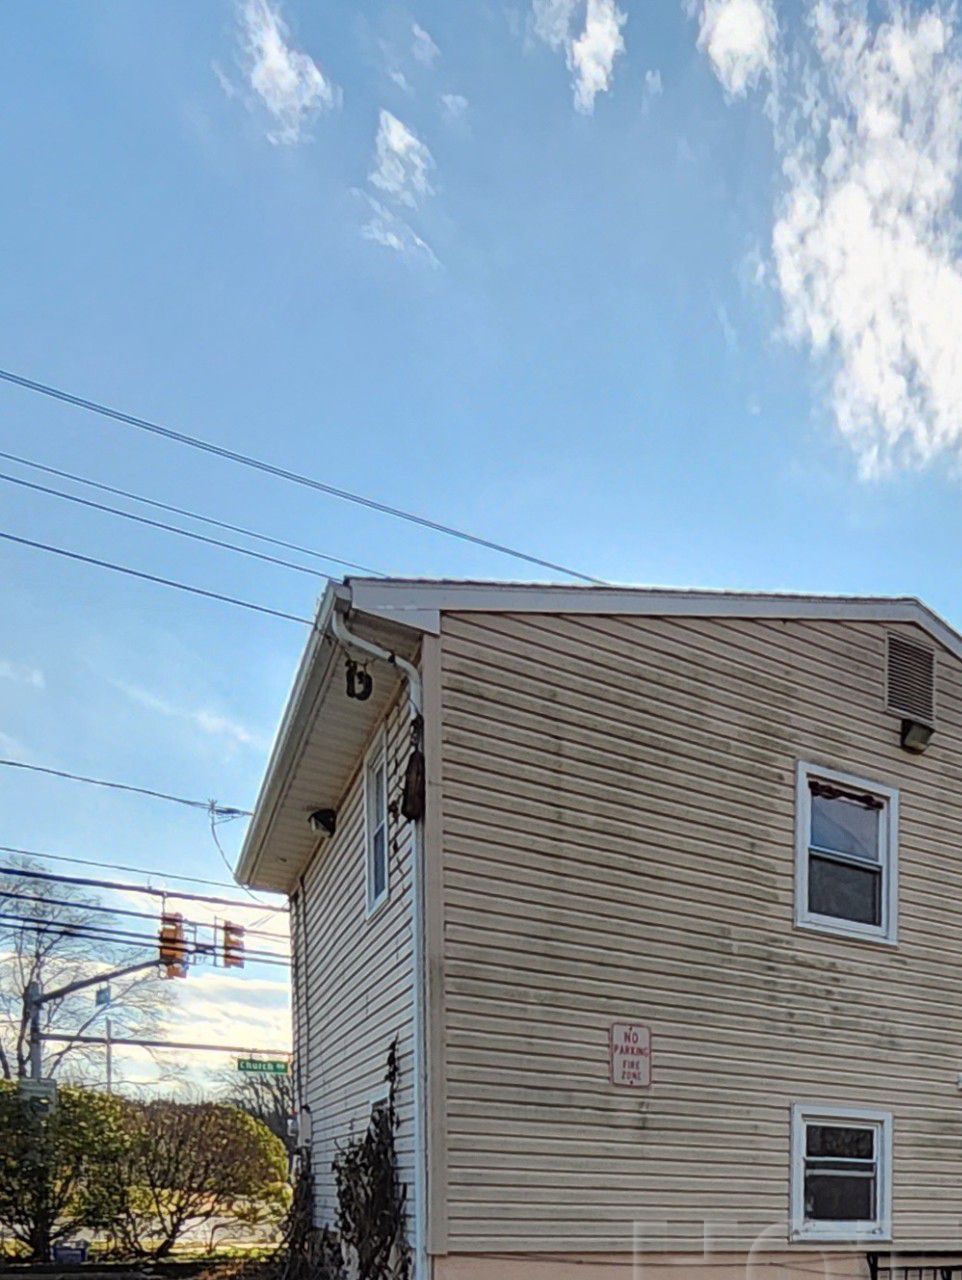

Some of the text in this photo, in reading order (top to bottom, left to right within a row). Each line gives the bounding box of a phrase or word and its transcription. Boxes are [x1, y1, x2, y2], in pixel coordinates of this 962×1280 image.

[624, 1032, 639, 1043] NO
[614, 1044, 649, 1057] PARKING
[240, 1061, 273, 1070] Church
[623, 1060, 640, 1069] FIRE
[621, 1071, 641, 1080] ZONE
